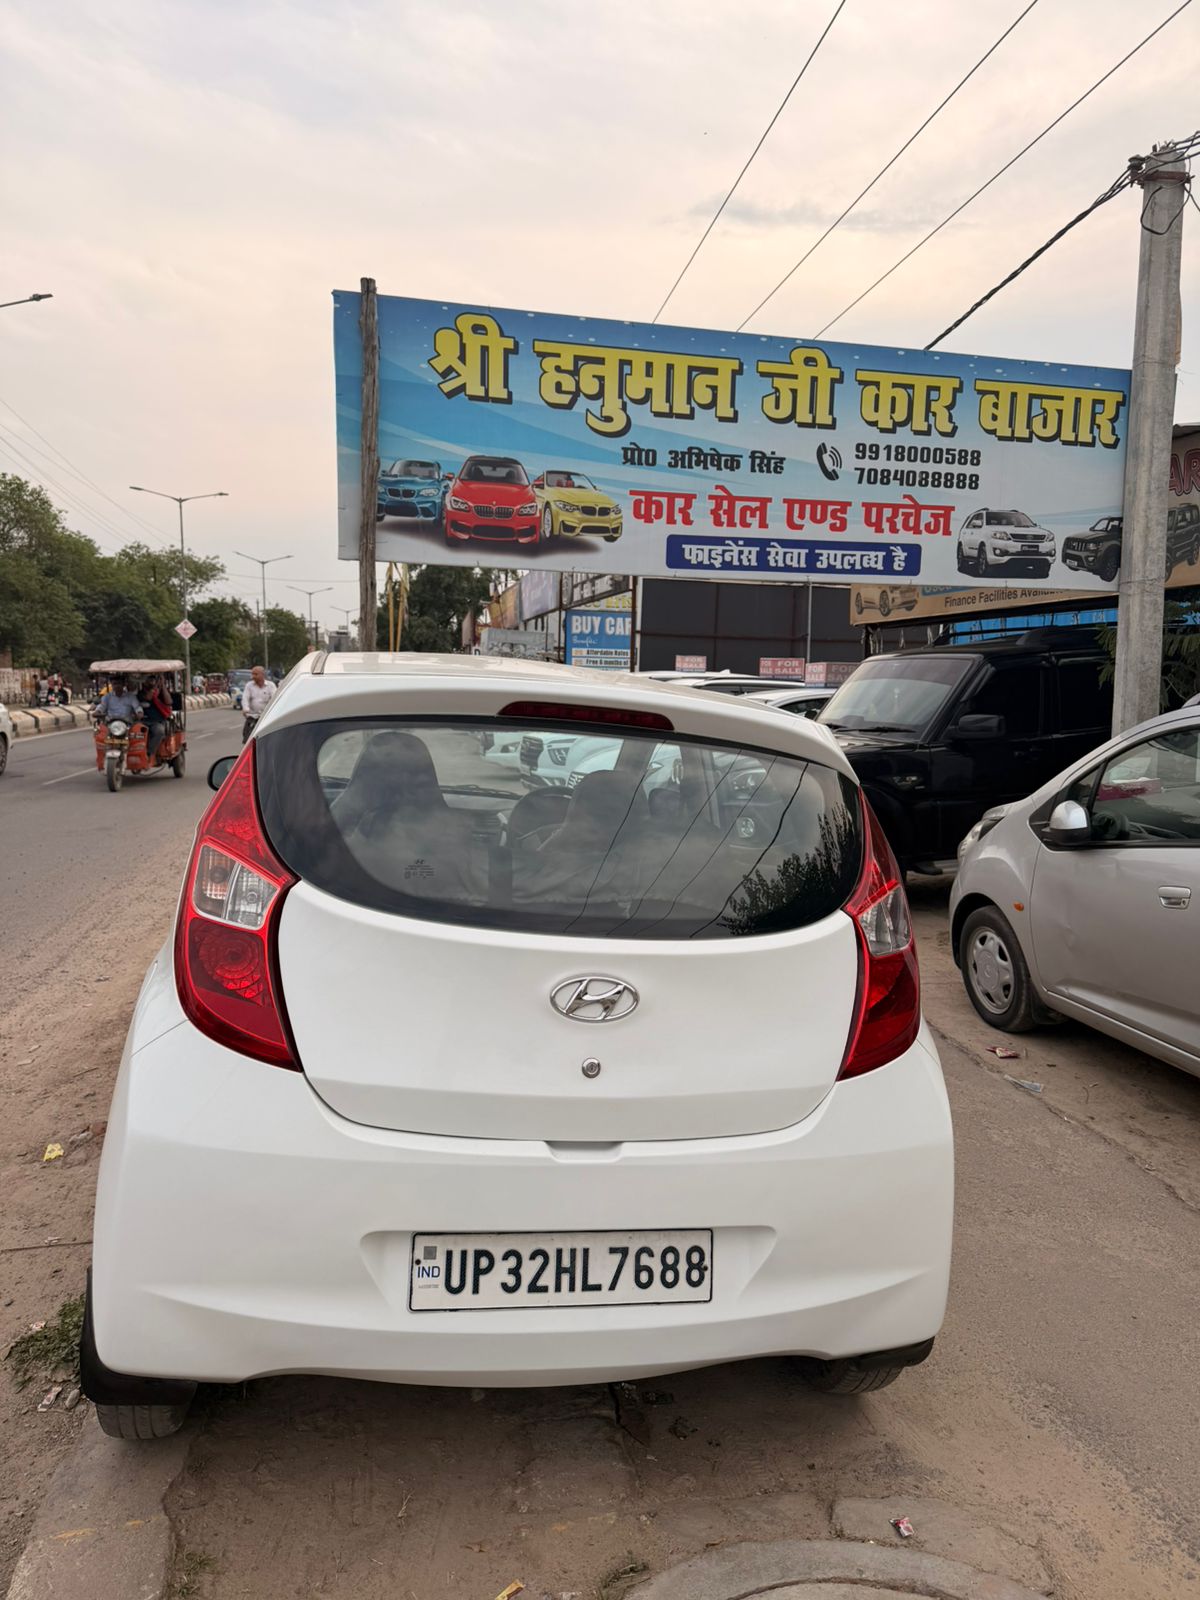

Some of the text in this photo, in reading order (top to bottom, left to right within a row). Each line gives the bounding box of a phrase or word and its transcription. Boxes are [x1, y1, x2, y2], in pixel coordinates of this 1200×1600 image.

[427, 312, 1126, 449] श्री हनुमान जी कार बाजार
[668, 446, 743, 471] अभिषेक
[749, 450, 786, 474] सिंह
[855, 443, 981, 466] 9918000588
[854, 467, 980, 490] 7084088888
[629, 484, 956, 537] कार सेल एण्ड परचेज
[682, 540, 907, 571] फाइनेंस सेवा उपलब्ध है
[944, 596, 976, 608] Finance
[978, 589, 1018, 603] Facilities
[571, 615, 601, 635] BUY
[809, 665, 823, 673] FOR
[417, 1265, 440, 1278] IND
[444, 1245, 706, 1295] UP32HL7688
